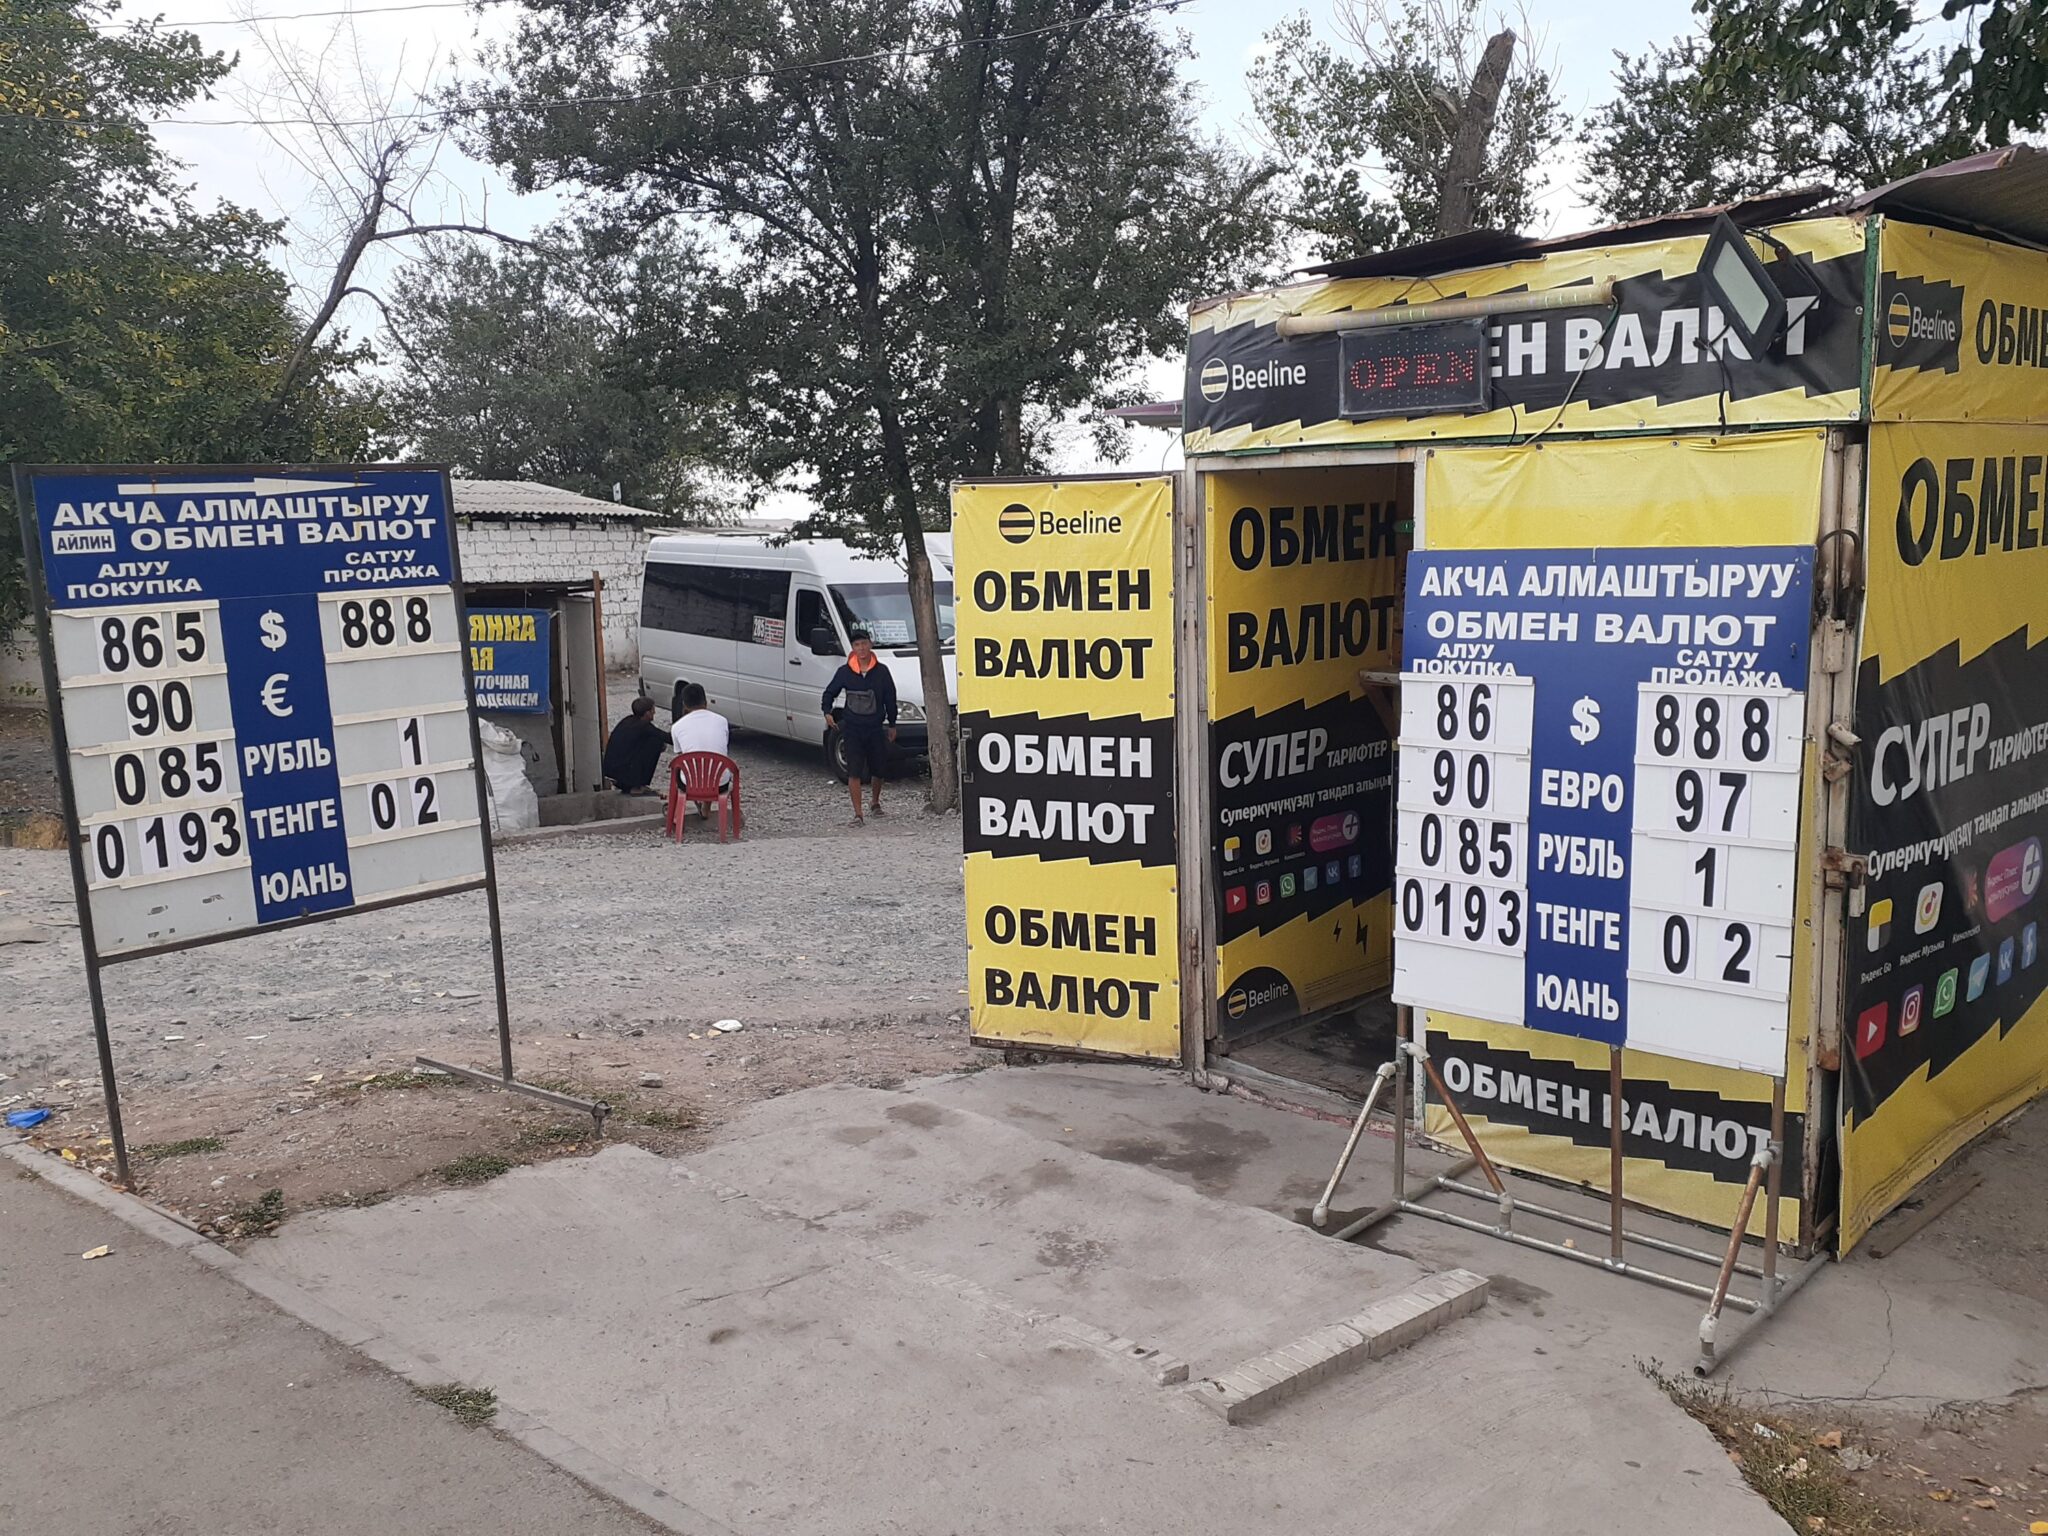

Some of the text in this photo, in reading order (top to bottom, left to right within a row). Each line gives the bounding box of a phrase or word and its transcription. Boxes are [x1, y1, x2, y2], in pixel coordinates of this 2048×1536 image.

[1911, 305, 1956, 342] Beeline
[1232, 363, 1306, 391] Beeline
[1350, 348, 1478, 390] OPEN
[53, 494, 430, 527] АКЧА АЛМАШТЫРУУ
[1039, 510, 1122, 535] Beeline
[1896, 454, 2048, 568] ОБМЕ
[57, 533, 113, 552] АЙЛИН
[130, 518, 437, 552] ОБМЕН ВАЛЮТ
[1229, 502, 1396, 571] ОБМЕН
[98, 560, 170, 579] АЛУУ
[323, 564, 441, 584] ПРОДАЖА
[345, 549, 417, 565] САТУУ
[67, 578, 203, 600] ПОКУПКА
[973, 568, 1152, 613] ОБМЕН
[1420, 564, 1796, 599] АКЧА АЛМАШТЫРУУ
[468, 614, 537, 642] ЯНКА
[1228, 595, 1395, 673] ВАЛЮТ
[1426, 610, 1777, 647] ОБМЕН ВАЛЮТ
[973, 637, 1154, 680] ВАЛЮТ
[1413, 658, 1517, 677] ПОКУПКА
[1437, 643, 1495, 660] АЛУУ
[1677, 649, 1759, 669] САТУУ
[1651, 666, 1783, 688] ПРОДАЖА
[127, 681, 193, 736] 90
[1437, 683, 1492, 741] 86
[244, 737, 332, 777] РУБЛЬ
[403, 718, 423, 767] 1
[977, 731, 1154, 779] ОБМЕН
[1219, 727, 1388, 789] СУПЕР ТАРИФТЕР
[1871, 702, 1990, 806] СУПЕР
[1317, 783, 1354, 802] тандап
[1433, 749, 1748, 833] 90 ЕВРО 97
[250, 798, 338, 840] ТЕНГЕ
[978, 796, 1156, 845] ВАЛЮТ
[1974, 803, 2009, 835] тандап
[260, 862, 348, 906] ЮАНЬ
[1538, 836, 1625, 881] РУБЛЬ
[1695, 847, 1716, 908] 1
[984, 905, 1158, 957] ОБМЕН
[1402, 878, 1521, 947] 0193
[1536, 903, 1621, 951] ТЕНГЕ
[1900, 940, 1945, 967] Яндекс Музыка
[984, 967, 1160, 1021] ВАЛЮТ
[1248, 982, 1289, 1008] Beeline
[1860, 966, 1884, 985] Яндекс
[1536, 973, 1621, 1022] ЮАНЬ
[1442, 1056, 1772, 1160] ОБМЕН ВАЛЮТ
